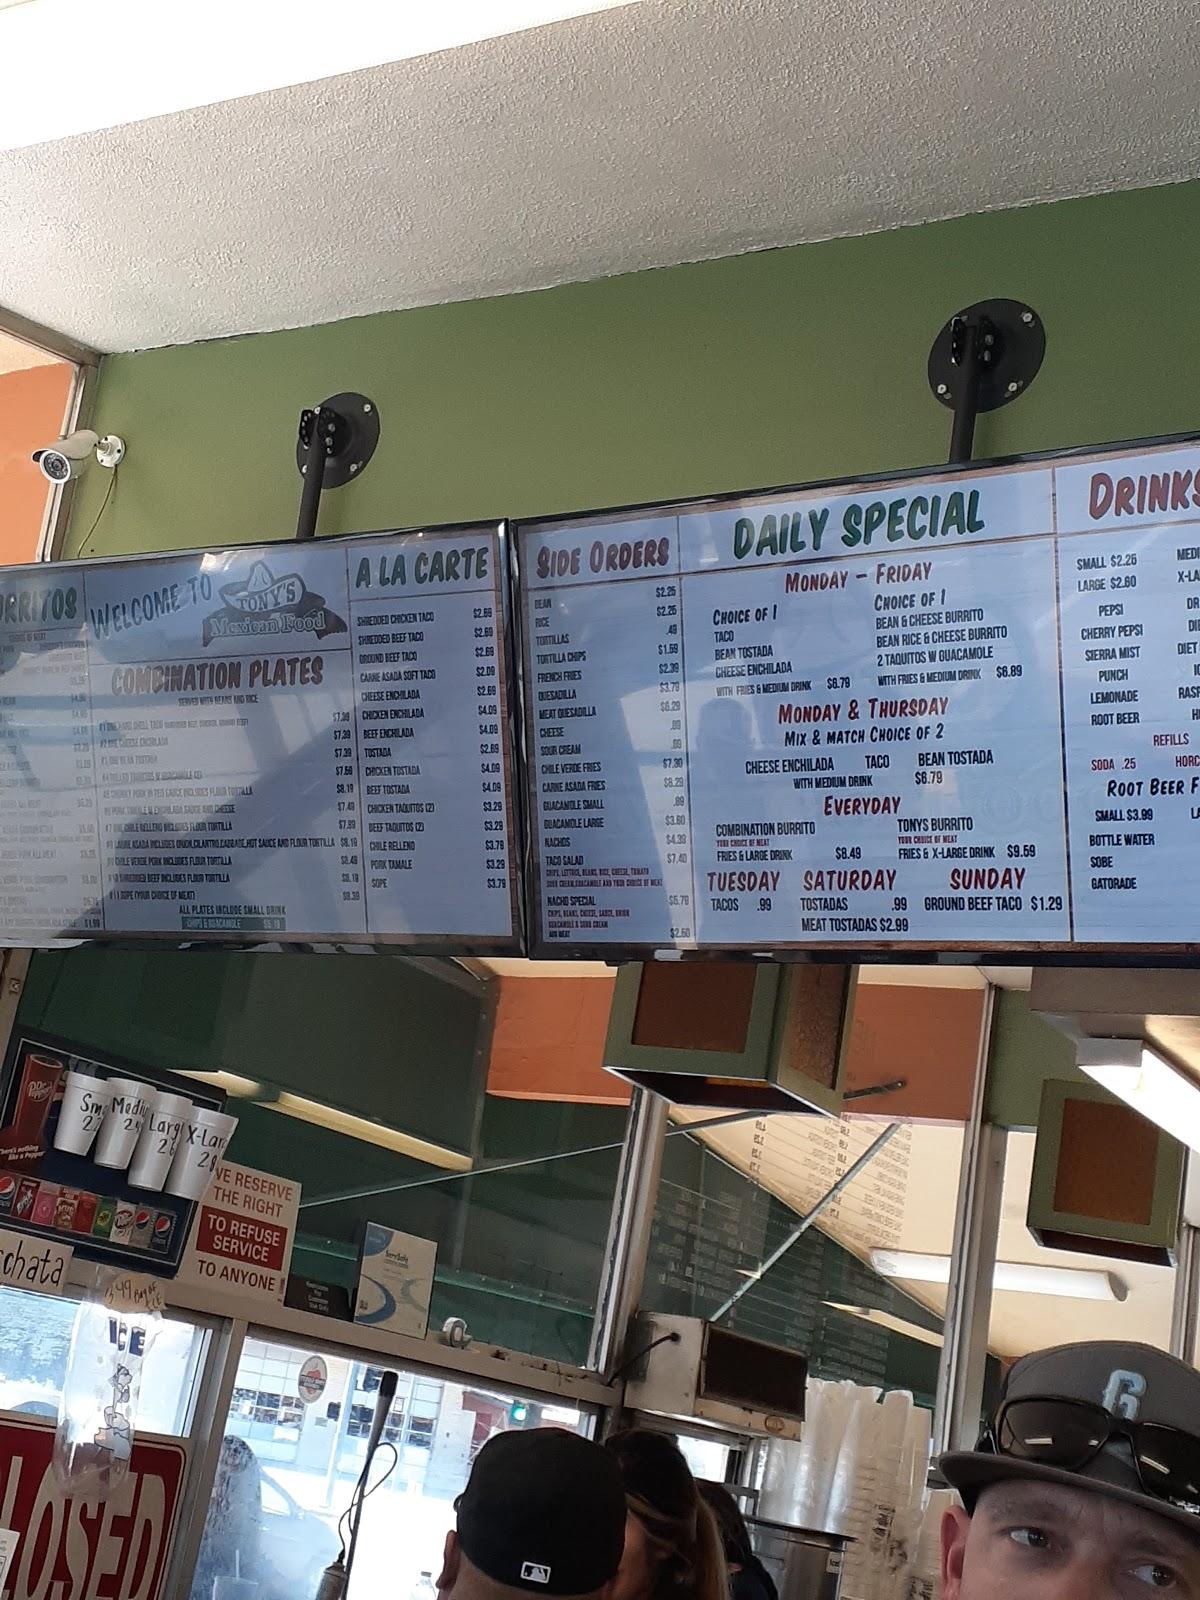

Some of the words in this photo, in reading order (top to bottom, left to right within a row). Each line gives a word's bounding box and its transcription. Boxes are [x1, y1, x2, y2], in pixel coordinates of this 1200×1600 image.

[734, 507, 829, 560] DAILY
[841, 490, 985, 547] SPECIAL
[537, 546, 581, 579] SIDE
[590, 537, 669, 573] ORDERS
[1077, 556, 1106, 571] SMALL
[356, 558, 371, 588] A
[379, 555, 406, 586] LA
[415, 547, 488, 584] CARTE
[785, 570, 848, 593] MONDAY
[876, 562, 933, 585] FRIDAY
[1078, 579, 1106, 592] LARGE
[1110, 576, 1136, 589] $2.60
[89, 584, 179, 640] WELCOME
[191, 574, 212, 607] TO
[874, 593, 916, 611] CHOICE
[921, 592, 935, 607] OF
[391, 613, 417, 624] CHICKEN
[418, 612, 434, 622] TACO
[713, 608, 750, 626] CHOICE
[754, 607, 768, 622] OF
[1099, 604, 1123, 616] PEPSI
[210, 617, 279, 637] Mexican
[282, 611, 326, 633] Food
[535, 617, 549, 628] RICE
[876, 617, 899, 630] BEAN
[909, 613, 943, 628] CHEESE
[945, 609, 984, 625] BURRITO
[714, 631, 734, 643] TACO
[877, 635, 900, 649] BEAN
[902, 633, 921, 646] RICE
[932, 630, 966, 644] CHEESE
[968, 626, 1008, 641] BURRITO
[1081, 626, 1115, 640] CHERRY
[1118, 624, 1143, 638] PEPSI
[715, 649, 736, 661] BEAN
[738, 646, 773, 659] TOSTADA
[1085, 648, 1117, 662] SIERRA
[1119, 646, 1140, 659] MIST
[1178, 642, 1198, 654] DIET
[537, 653, 566, 665] TORTILLA
[567, 651, 586, 663] CHIPS
[877, 654, 883, 667] 2
[885, 651, 926, 667] TAQUITOS
[928, 650, 936, 663] W
[938, 646, 994, 662] GUACAMOLE
[111, 661, 242, 696] COMBINATION
[249, 655, 323, 688] PLATES
[538, 672, 562, 683] FRENCH
[563, 670, 582, 681] FRIES
[715, 665, 746, 679] CHEESE
[747, 661, 792, 676] ENCHILADA
[878, 674, 896, 686] WITH
[898, 672, 918, 685] FRIES
[926, 670, 957, 683] MEDIUM
[959, 668, 981, 681] DRINK
[1099, 669, 1128, 682] PUNCH
[1091, 690, 1138, 705] LEMONADE
[778, 703, 841, 725] MONDAY
[848, 701, 859, 720] &
[868, 697, 949, 719] THURSDAY
[1091, 713, 1115, 726] ROOT
[1117, 712, 1140, 725] BEER
[364, 728, 378, 739] BEEF
[380, 727, 414, 738] ENCHILADA
[784, 730, 807, 747] MIX
[812, 730, 821, 745] &
[826, 728, 865, 744] MATCH
[870, 725, 911, 743] CHOICE
[916, 725, 930, 740] OF
[936, 723, 944, 739] 2
[1154, 733, 1189, 746] REFILLS
[541, 764, 559, 774] CHILE
[560, 763, 581, 773] VERDE
[582, 762, 601, 772] FRIES
[745, 760, 780, 774] CHEESE
[782, 757, 834, 773] ENCHILADA
[865, 755, 890, 769] TACO
[918, 752, 945, 767] BEAN
[948, 749, 993, 765] TOSTADA
[1091, 759, 1114, 771] SODA
[1122, 758, 1136, 770] .25
[793, 778, 813, 789] WITH
[814, 776, 846, 788] MEDIUM
[848, 775, 873, 787] DRINK
[1107, 780, 1143, 797] ROOT
[1150, 778, 1185, 796] BEER
[823, 795, 901, 817] EVERYDAY
[1095, 810, 1125, 822] SMALL
[1127, 808, 1154, 821] $3.99
[716, 822, 775, 837] COMBINATION
[777, 821, 816, 835] BURRITO
[898, 818, 928, 833] TONYS
[931, 816, 973, 831] BURRITO
[370, 841, 387, 851] CHILE
[388, 841, 415, 850] RELLENO
[1089, 834, 1122, 847] BOTTLE
[1124, 833, 1155, 846] WATER
[835, 846, 862, 860] $8.49
[898, 847, 920, 860] FRIES
[932, 846, 968, 859] X-LARGE
[969, 845, 995, 858] DRINK
[1091, 856, 1113, 868] SOBE
[707, 871, 781, 892] TUESDAY
[803, 870, 897, 891] SATURDAY
[950, 868, 1026, 890] SUNDAY
[1091, 877, 1137, 890] GATORADE
[711, 898, 739, 912] TACOS
[756, 898, 772, 911] .99
[800, 898, 848, 911] TOSTADAS
[891, 898, 907, 911] .99
[924, 897, 965, 911] GROUND
[968, 897, 993, 911] BEEF
[996, 896, 1022, 911] TACO
[1031, 896, 1063, 911] $1.29
[801, 918, 827, 932] MEAT
[829, 918, 878, 932] TOSTADAS
[879, 918, 908, 932] $2.99
[235, 1172, 293, 1201] RESERVE
[214, 1186, 239, 1206] THE
[243, 1196, 283, 1217] RIGHT
[208, 1214, 227, 1232] TO
[230, 1220, 281, 1247] REFUSE
[213, 1235, 269, 1262] SERVICE
[198, 1259, 216, 1276] TO
[220, 1266, 276, 1292] ANYONE
[108, 1316, 146, 1357] ICE
